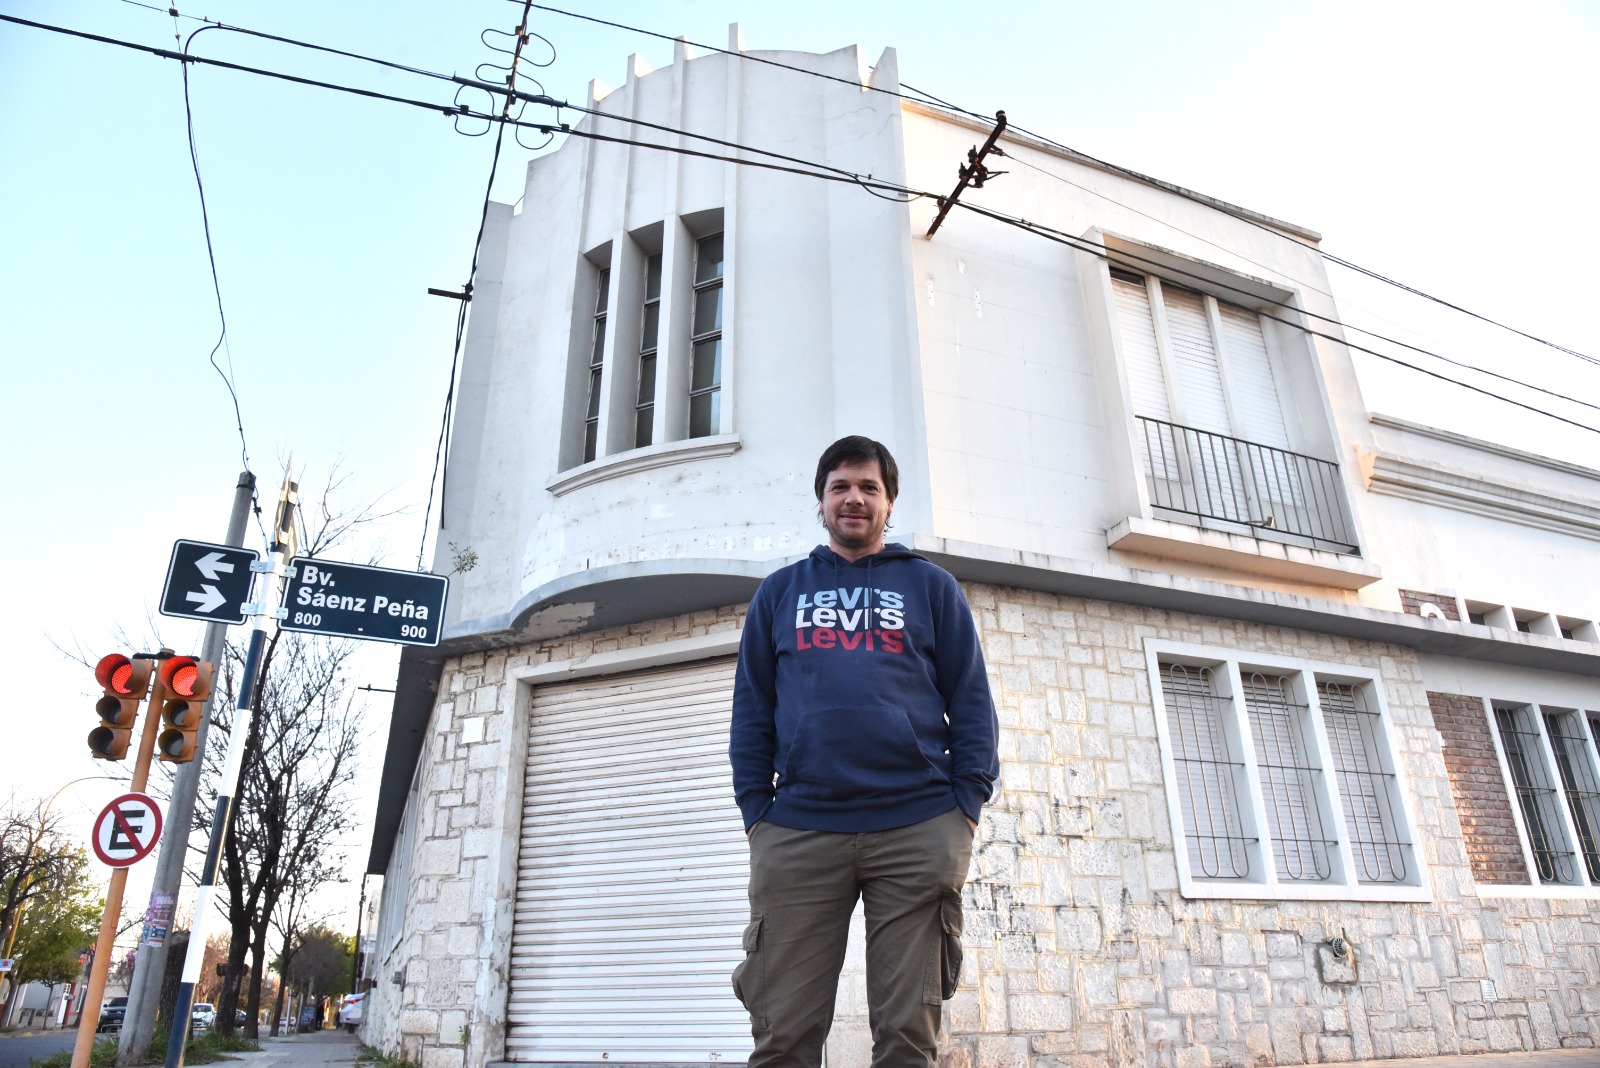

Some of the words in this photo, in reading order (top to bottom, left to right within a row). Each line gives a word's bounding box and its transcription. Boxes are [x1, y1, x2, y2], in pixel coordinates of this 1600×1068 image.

[302, 565, 336, 587] Bv.
[296, 587, 366, 613] Sáenz
[372, 596, 429, 620] Peña
[294, 612, 322, 627] 800
[400, 624, 428, 639] 900
[108, 809, 146, 850] E
